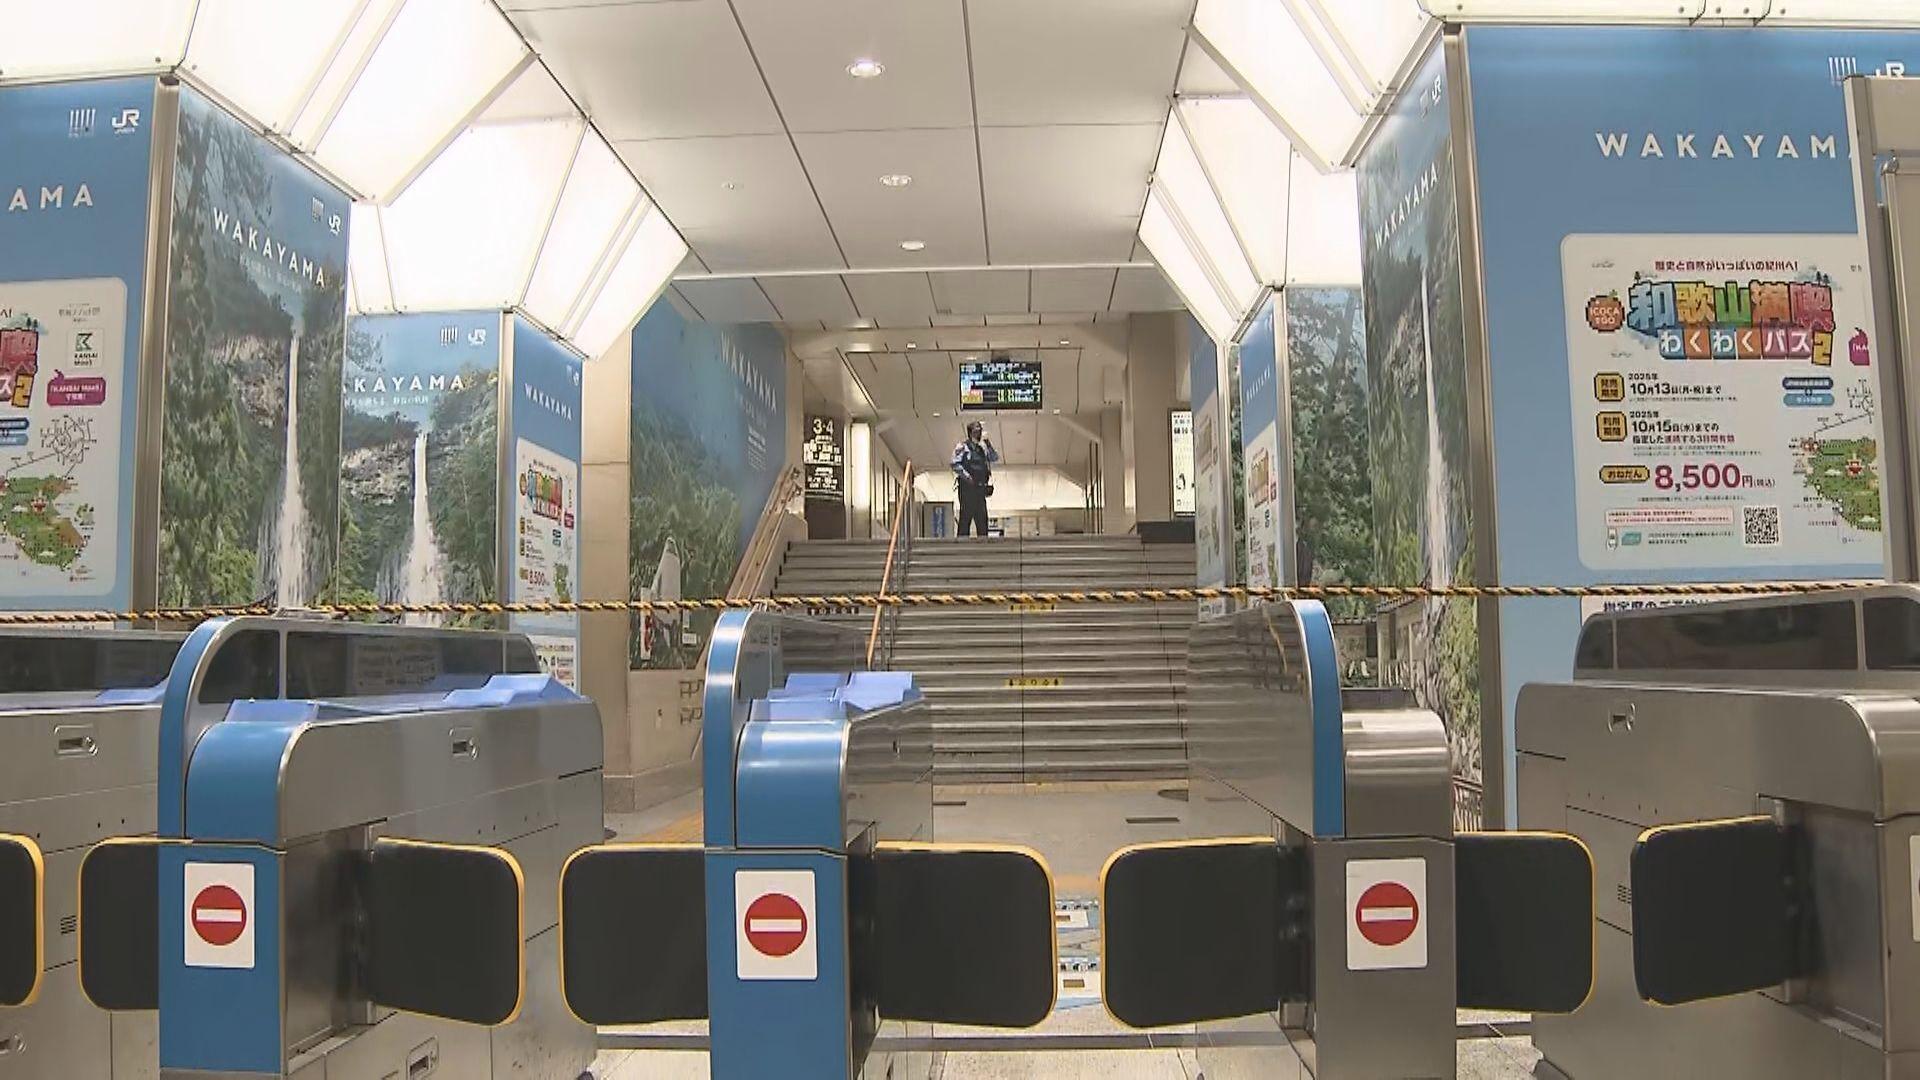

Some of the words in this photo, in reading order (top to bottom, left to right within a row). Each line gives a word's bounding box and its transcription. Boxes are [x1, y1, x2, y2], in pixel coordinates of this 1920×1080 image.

[111, 109, 140, 129] JR
[1595, 132, 1853, 160] WAKAYAM
[1375, 162, 1439, 249] WAKAYAMA
[213, 206, 325, 288] WAKAYAMA
[1590, 307, 1620, 316] ICOCA
[342, 374, 465, 393] KAYAMA
[720, 331, 777, 415] WAKAYAMA
[524, 383, 573, 421] WAKAYAMA
